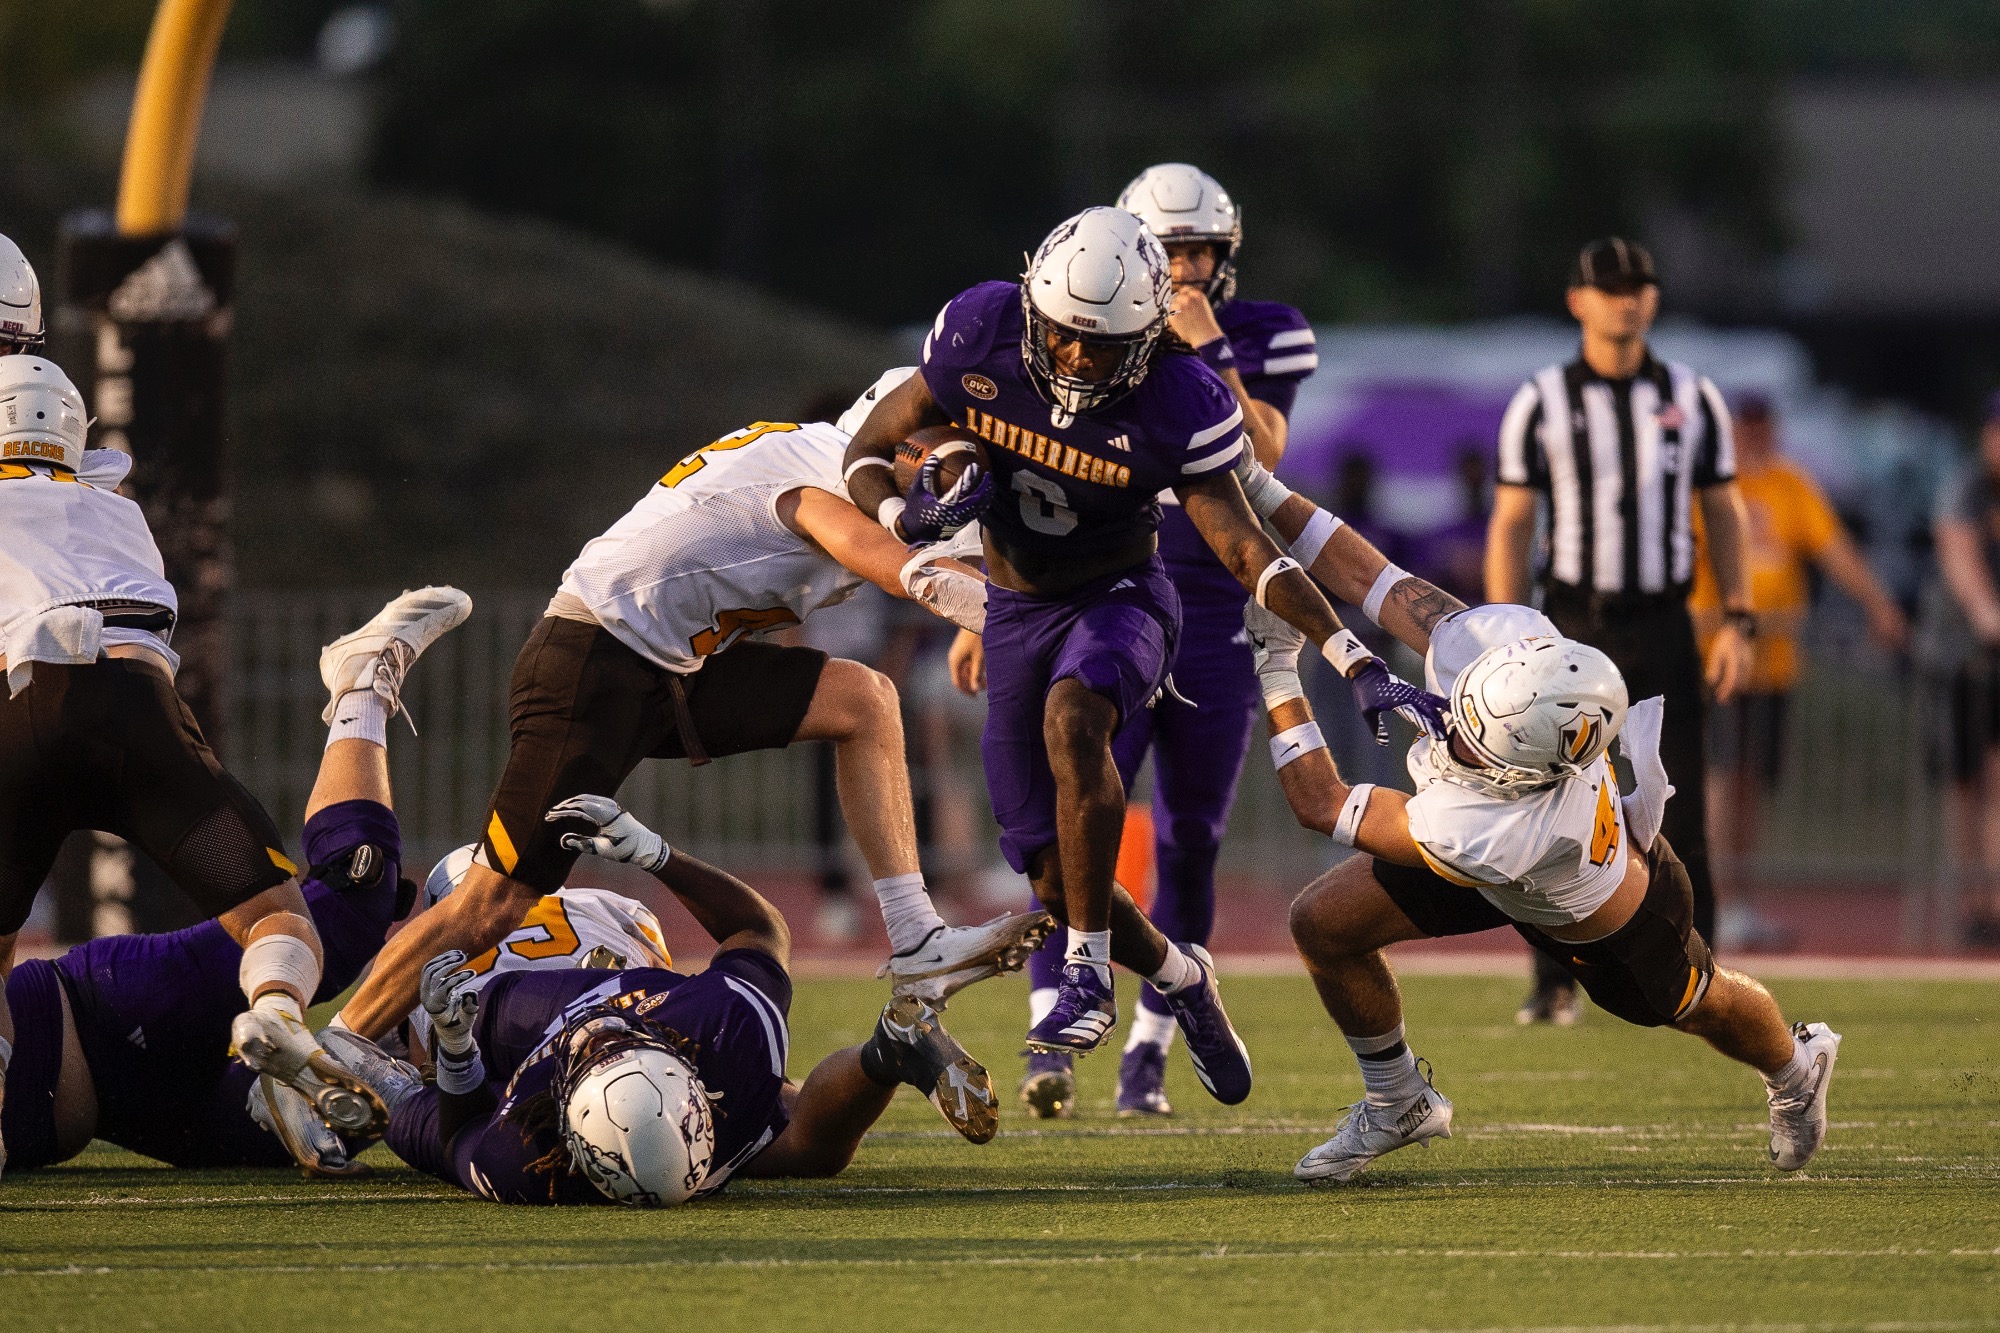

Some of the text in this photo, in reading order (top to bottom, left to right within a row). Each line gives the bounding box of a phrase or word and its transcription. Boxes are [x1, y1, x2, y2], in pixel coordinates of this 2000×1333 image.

[969, 380, 990, 394] OVC
[3, 440, 65, 461] BEACONS
[966, 406, 1132, 489] LEATHERNECKS
[600, 1052, 625, 1069] NECKS
